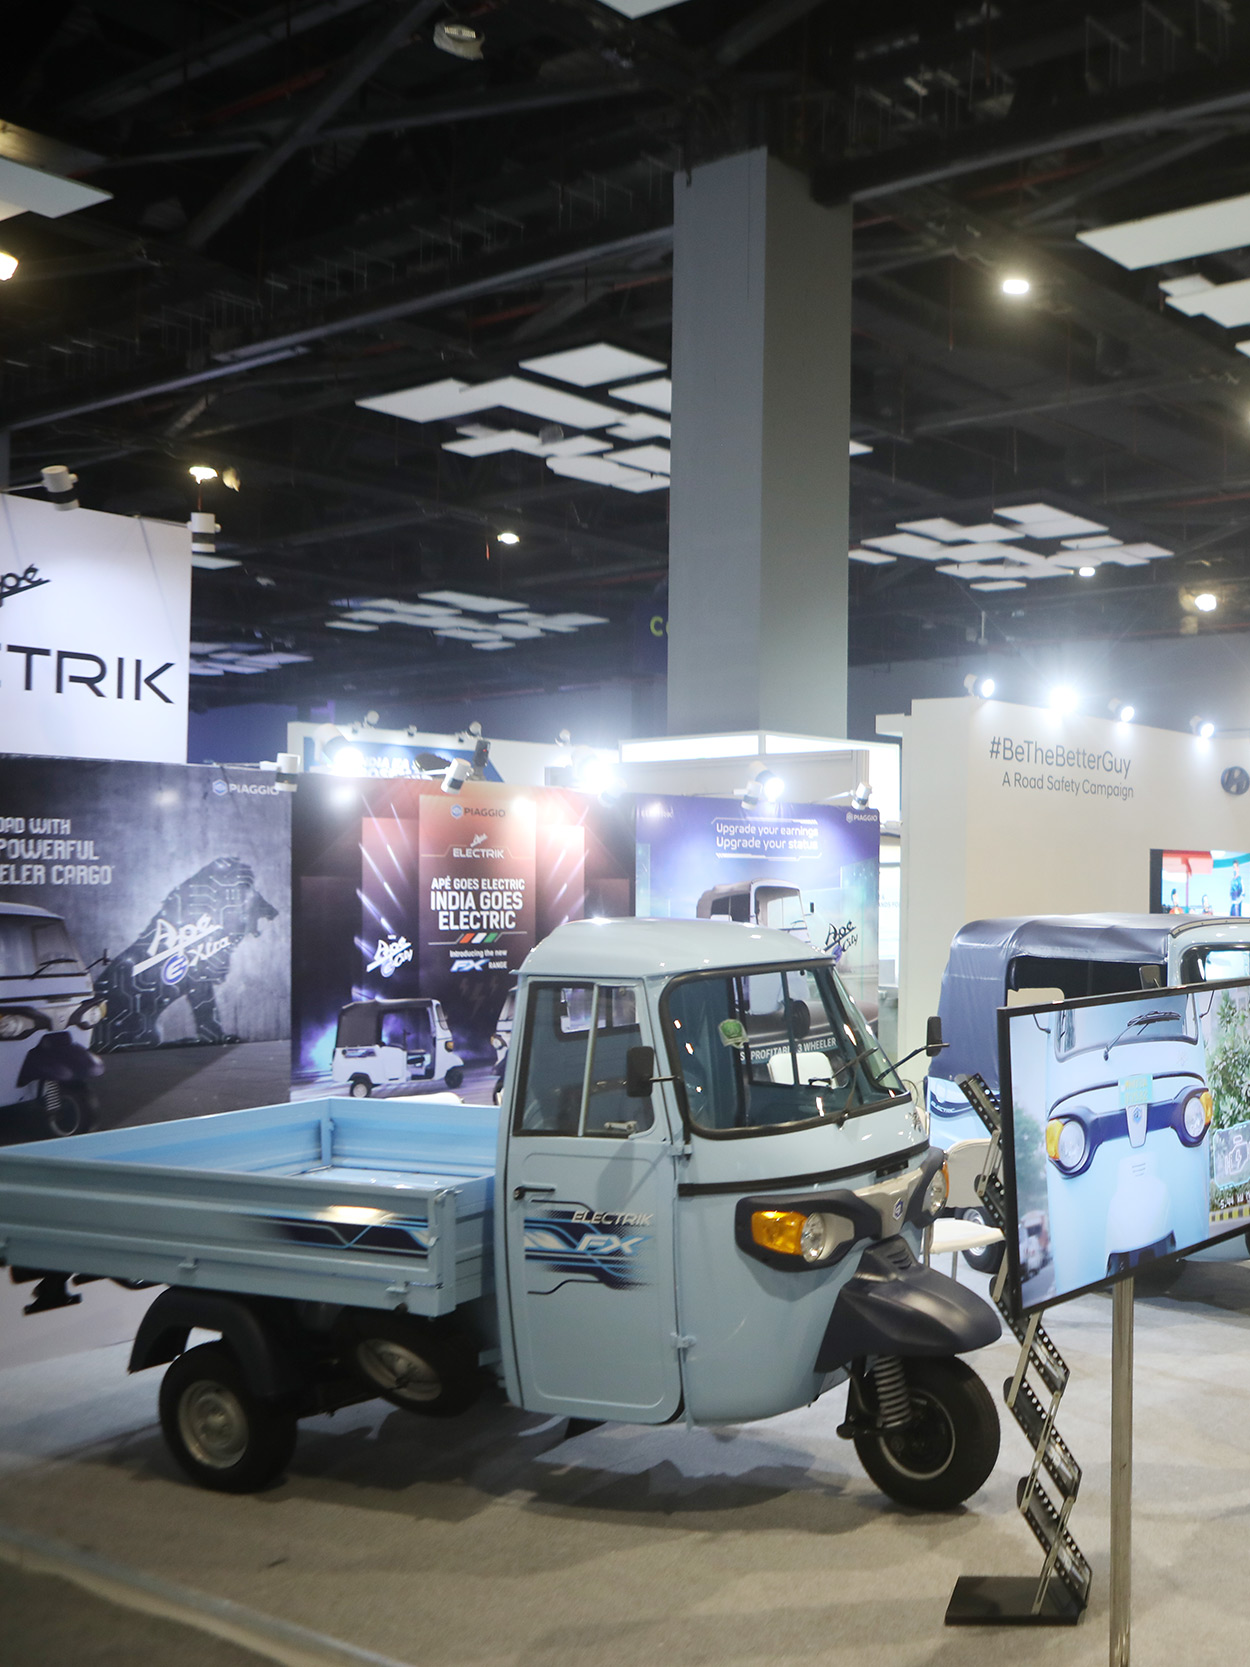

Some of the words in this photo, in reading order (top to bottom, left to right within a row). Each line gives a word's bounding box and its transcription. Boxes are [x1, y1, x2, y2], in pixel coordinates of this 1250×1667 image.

[0, 642, 175, 705] TRIK
[989, 736, 1131, 780] #BeTheBetterGuy
[229, 783, 280, 796] PIAGGIO
[1002, 771, 1011, 787] A
[1014, 772, 1044, 790] Road
[1047, 775, 1081, 796] Safety
[1082, 779, 1134, 801] Campaign
[464, 807, 506, 818] PIAGGIO
[853, 813, 878, 822] PIAGGIO
[29, 817, 71, 835] WITH
[716, 823, 756, 837] Upgrade
[758, 826, 778, 837] your
[781, 826, 819, 838] earnings
[0, 838, 100, 861] POWERFUL
[716, 836, 761, 851] Upgrade
[763, 840, 786, 851] your
[788, 839, 818, 850] status
[453, 847, 504, 859] ELECTRIK
[0, 864, 46, 886] ELER
[51, 864, 112, 886] CARGO
[453, 878, 479, 890] GOES
[481, 878, 525, 891] ELECTRIC
[430, 891, 476, 910] INDIA
[480, 891, 523, 910] GOES
[438, 911, 516, 931] ELECTRIC
[449, 949, 484, 958] Introducing
[484, 949, 494, 957] the
[450, 958, 490, 972] FX
[488, 961, 508, 969] RANGE
[803, 1037, 837, 1052] WHEELER
[571, 1210, 654, 1226] ELECTRIK
[576, 1233, 648, 1255] FX
